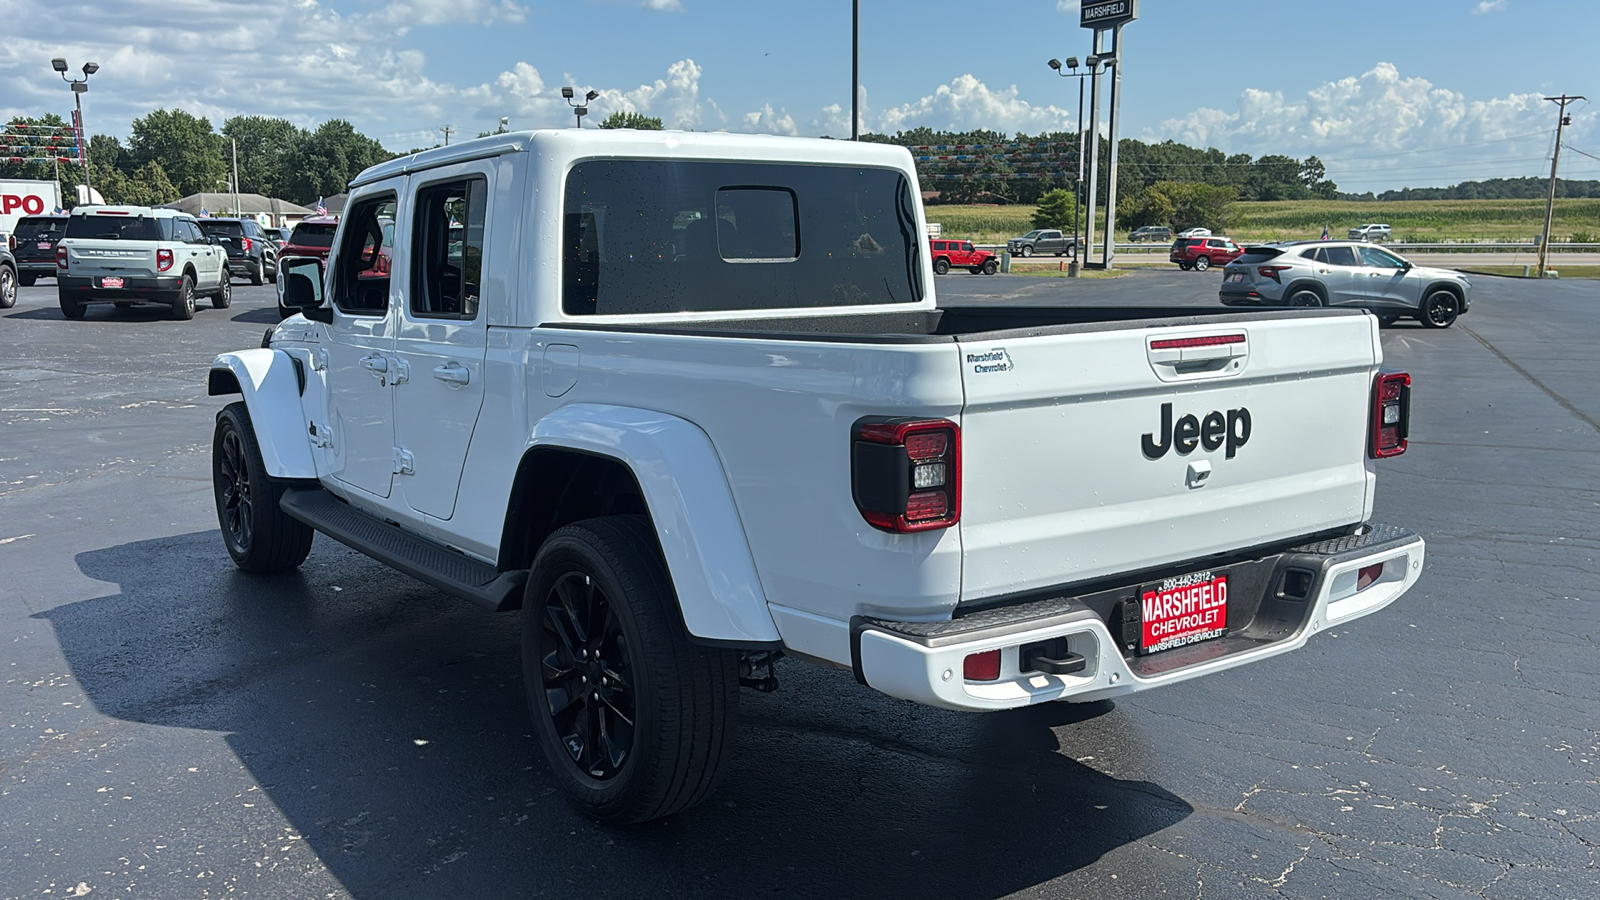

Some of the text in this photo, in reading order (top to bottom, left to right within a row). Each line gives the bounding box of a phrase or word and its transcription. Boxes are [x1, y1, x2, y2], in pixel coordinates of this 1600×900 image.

[1085, 3, 1125, 19] MARSHFIELD
[0, 194, 44, 215] PO
[967, 351, 1003, 363] Marshfield
[974, 363, 1007, 373] Chevrolet
[1141, 402, 1252, 460] Jeep
[1163, 571, 1211, 589] 800-440-2312
[1142, 582, 1227, 623] MARSHFIELD
[1151, 609, 1219, 637] CHEVROLET
[1148, 629, 1223, 653] MARSHFIELD CHEVROLET
